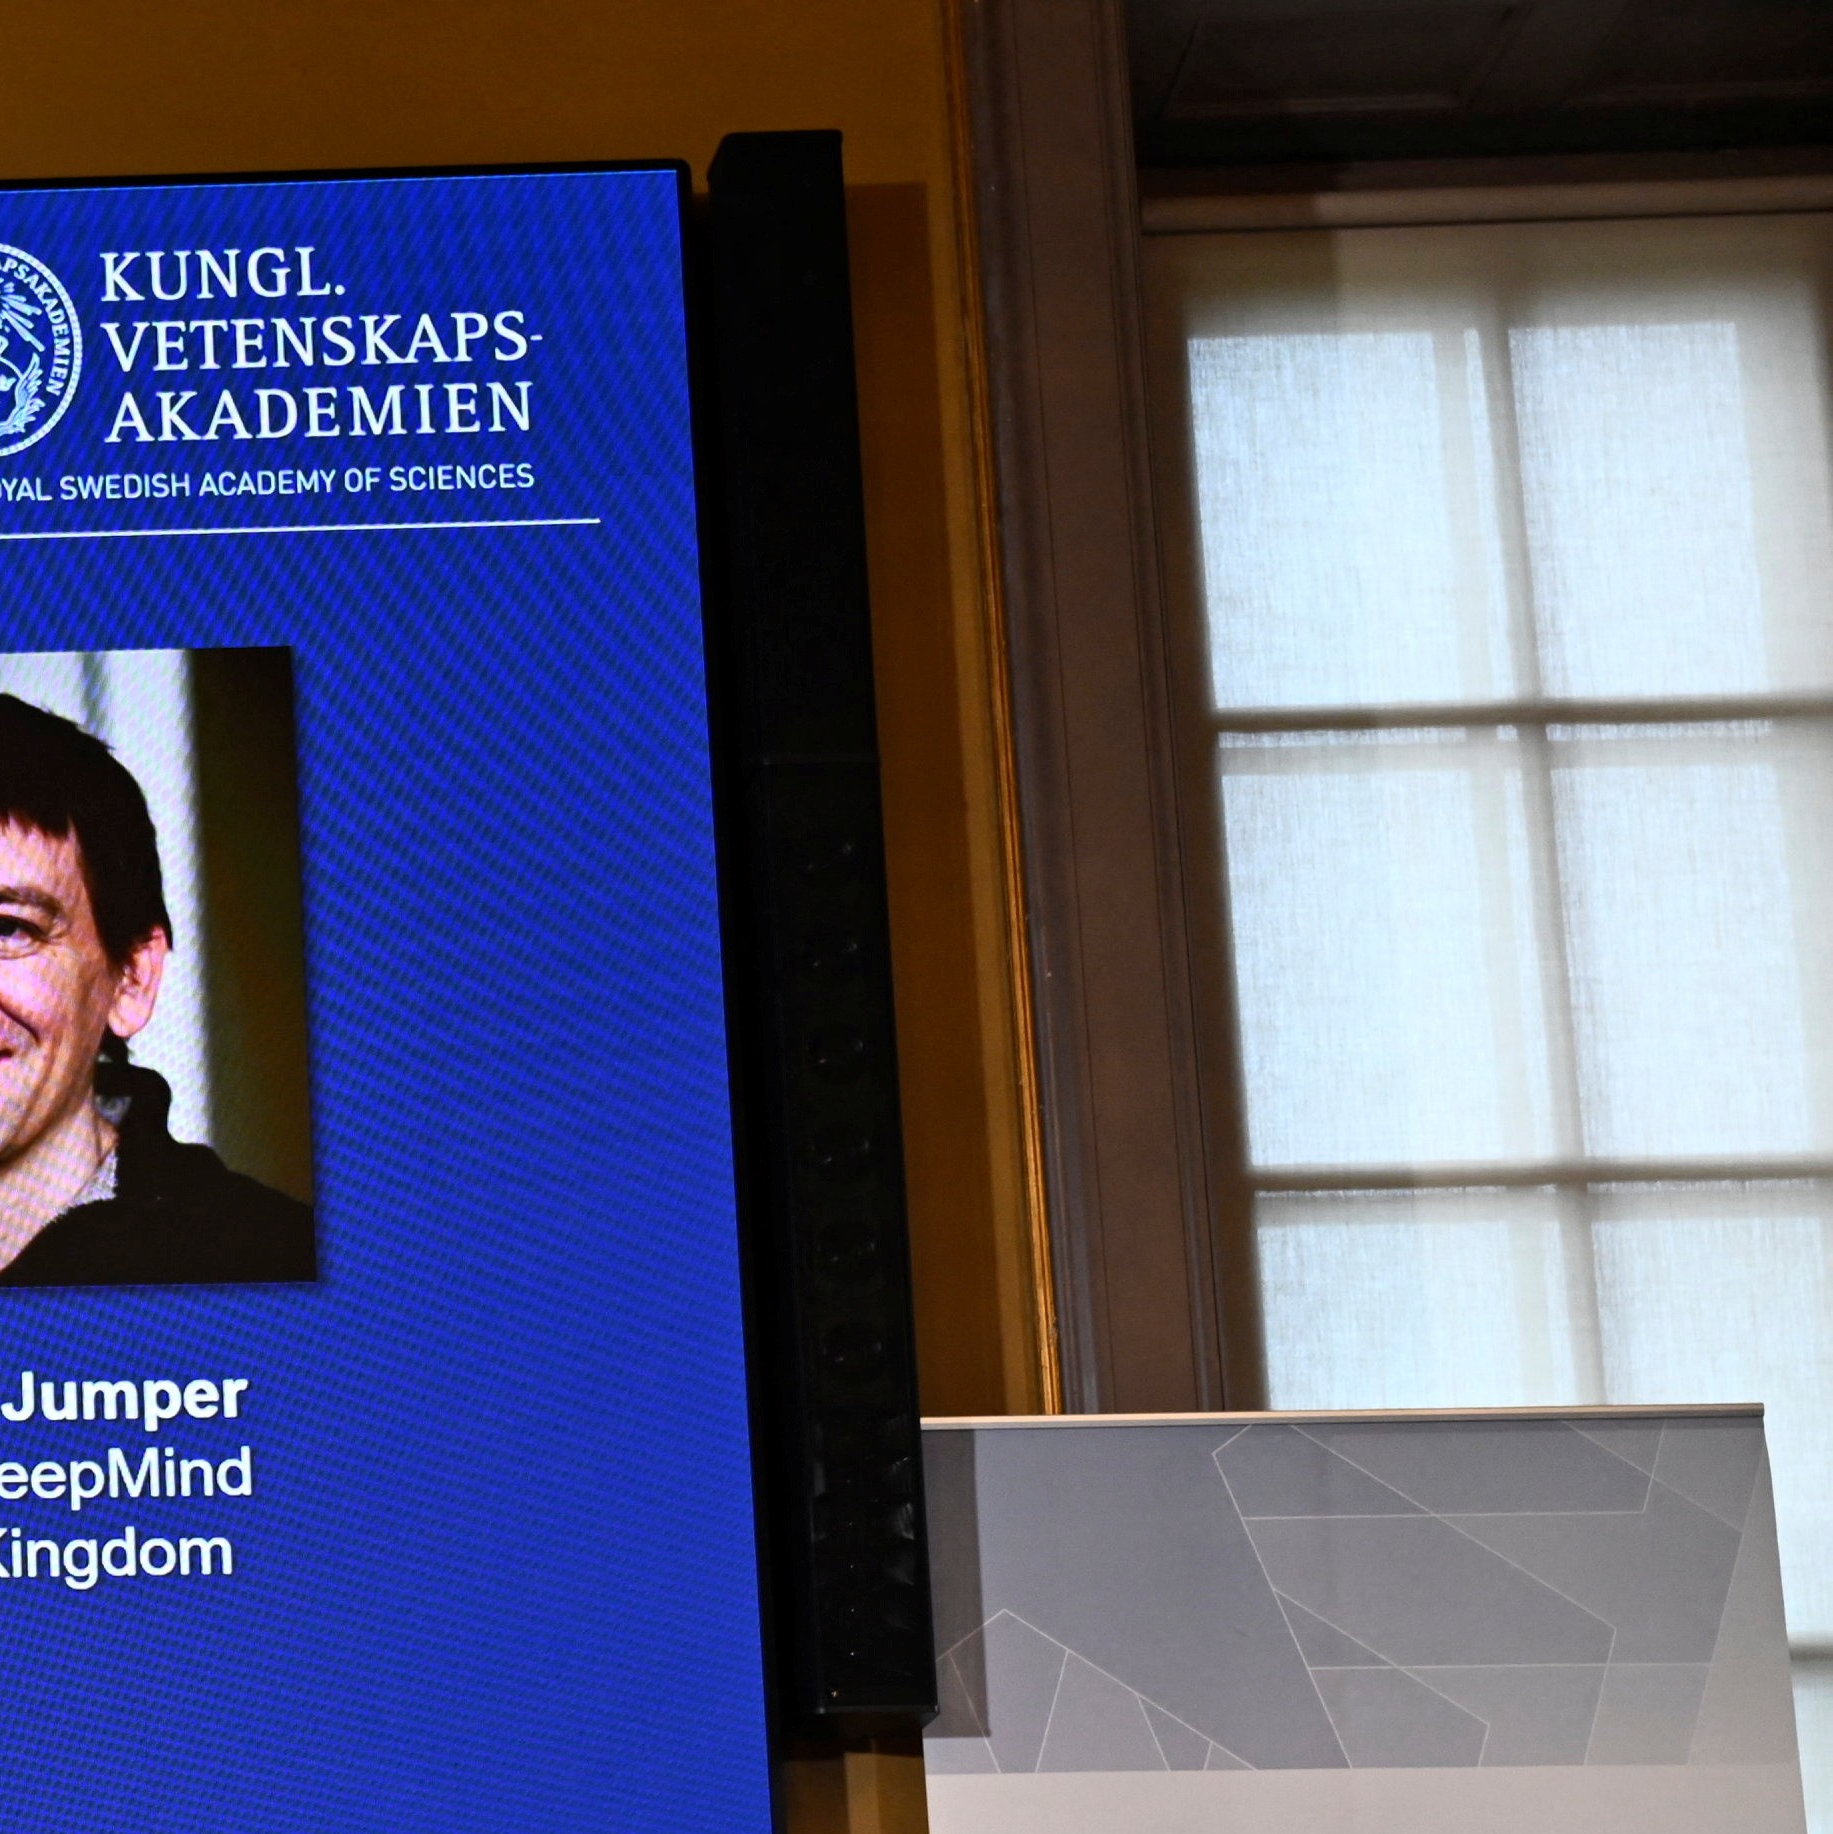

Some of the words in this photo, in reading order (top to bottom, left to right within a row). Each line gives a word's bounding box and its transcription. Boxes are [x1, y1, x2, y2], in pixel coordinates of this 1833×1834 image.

[101, 248, 344, 301] KUNGL.
[101, 311, 542, 371] VETENSKAPS-
[105, 382, 531, 442] AKADEMIEN
[60, 474, 189, 499] SWEDISH
[200, 470, 335, 496] ACADEMY
[345, 468, 380, 492] OF
[390, 464, 534, 490] SCIENCES
[1, 1372, 248, 1431] Jumper
